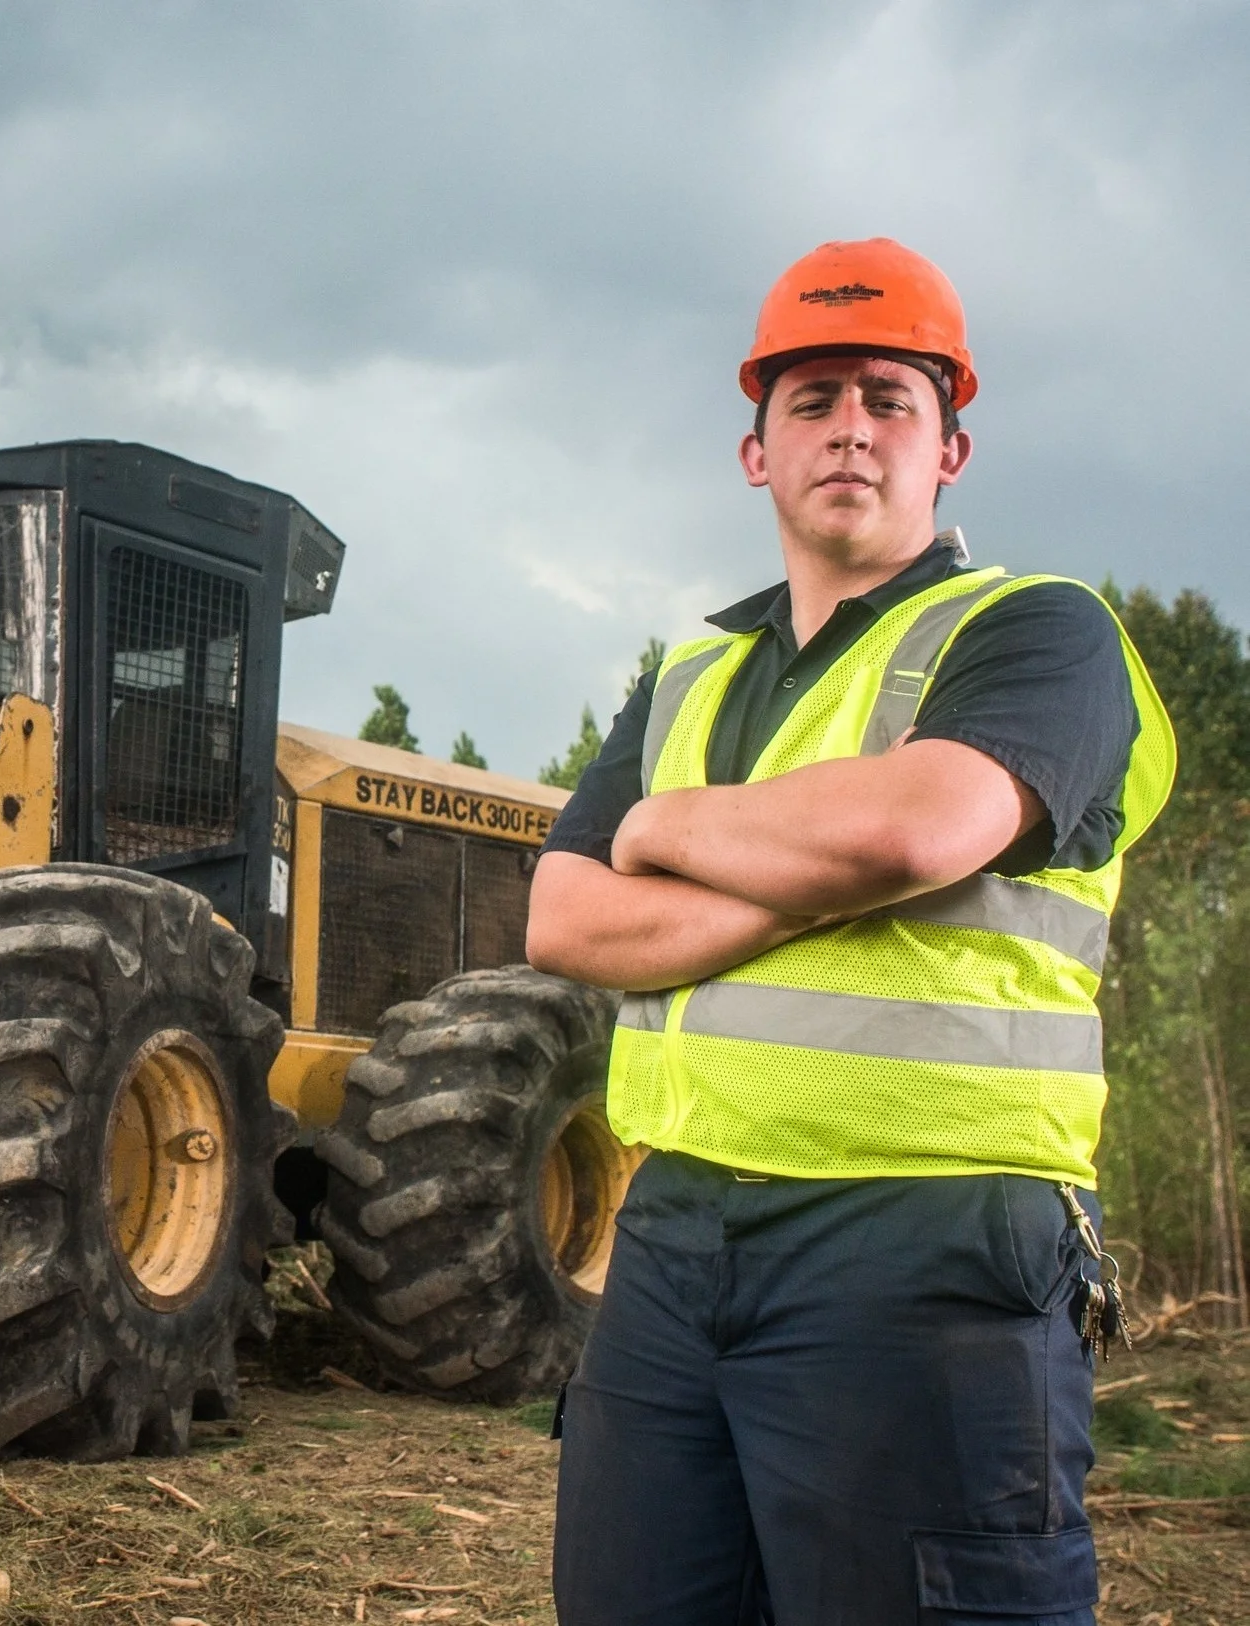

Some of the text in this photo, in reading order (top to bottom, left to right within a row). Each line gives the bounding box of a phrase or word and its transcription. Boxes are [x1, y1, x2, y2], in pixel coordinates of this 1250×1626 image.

[356, 775, 557, 838] STAY BACK 300 FE
